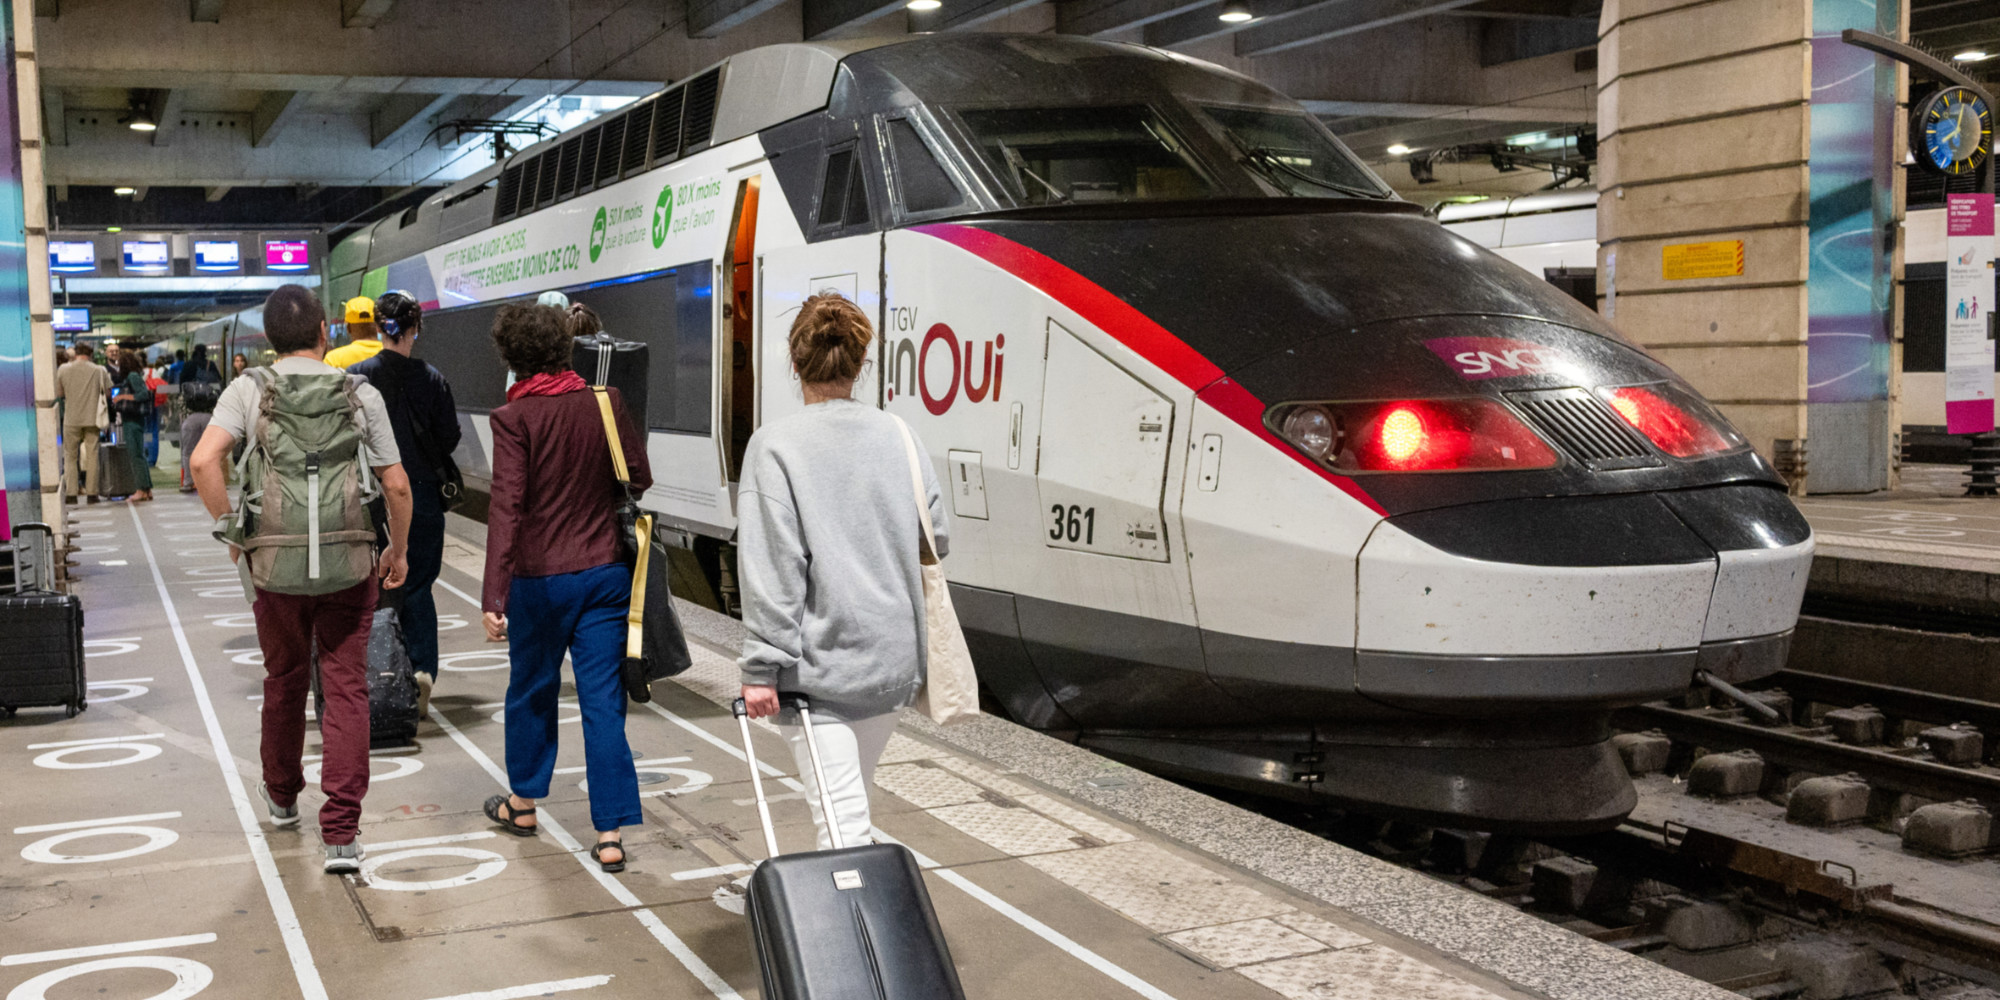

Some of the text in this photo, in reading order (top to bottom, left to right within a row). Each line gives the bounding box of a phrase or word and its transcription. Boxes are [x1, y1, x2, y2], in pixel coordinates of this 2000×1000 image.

[677, 185, 688, 206] 80
[696, 178, 721, 201] moins
[623, 201, 643, 222] moins
[520, 251, 548, 279] MOINS
[548, 248, 562, 273] DE
[890, 306, 918, 331] TGV
[1049, 503, 1096, 546] 361
